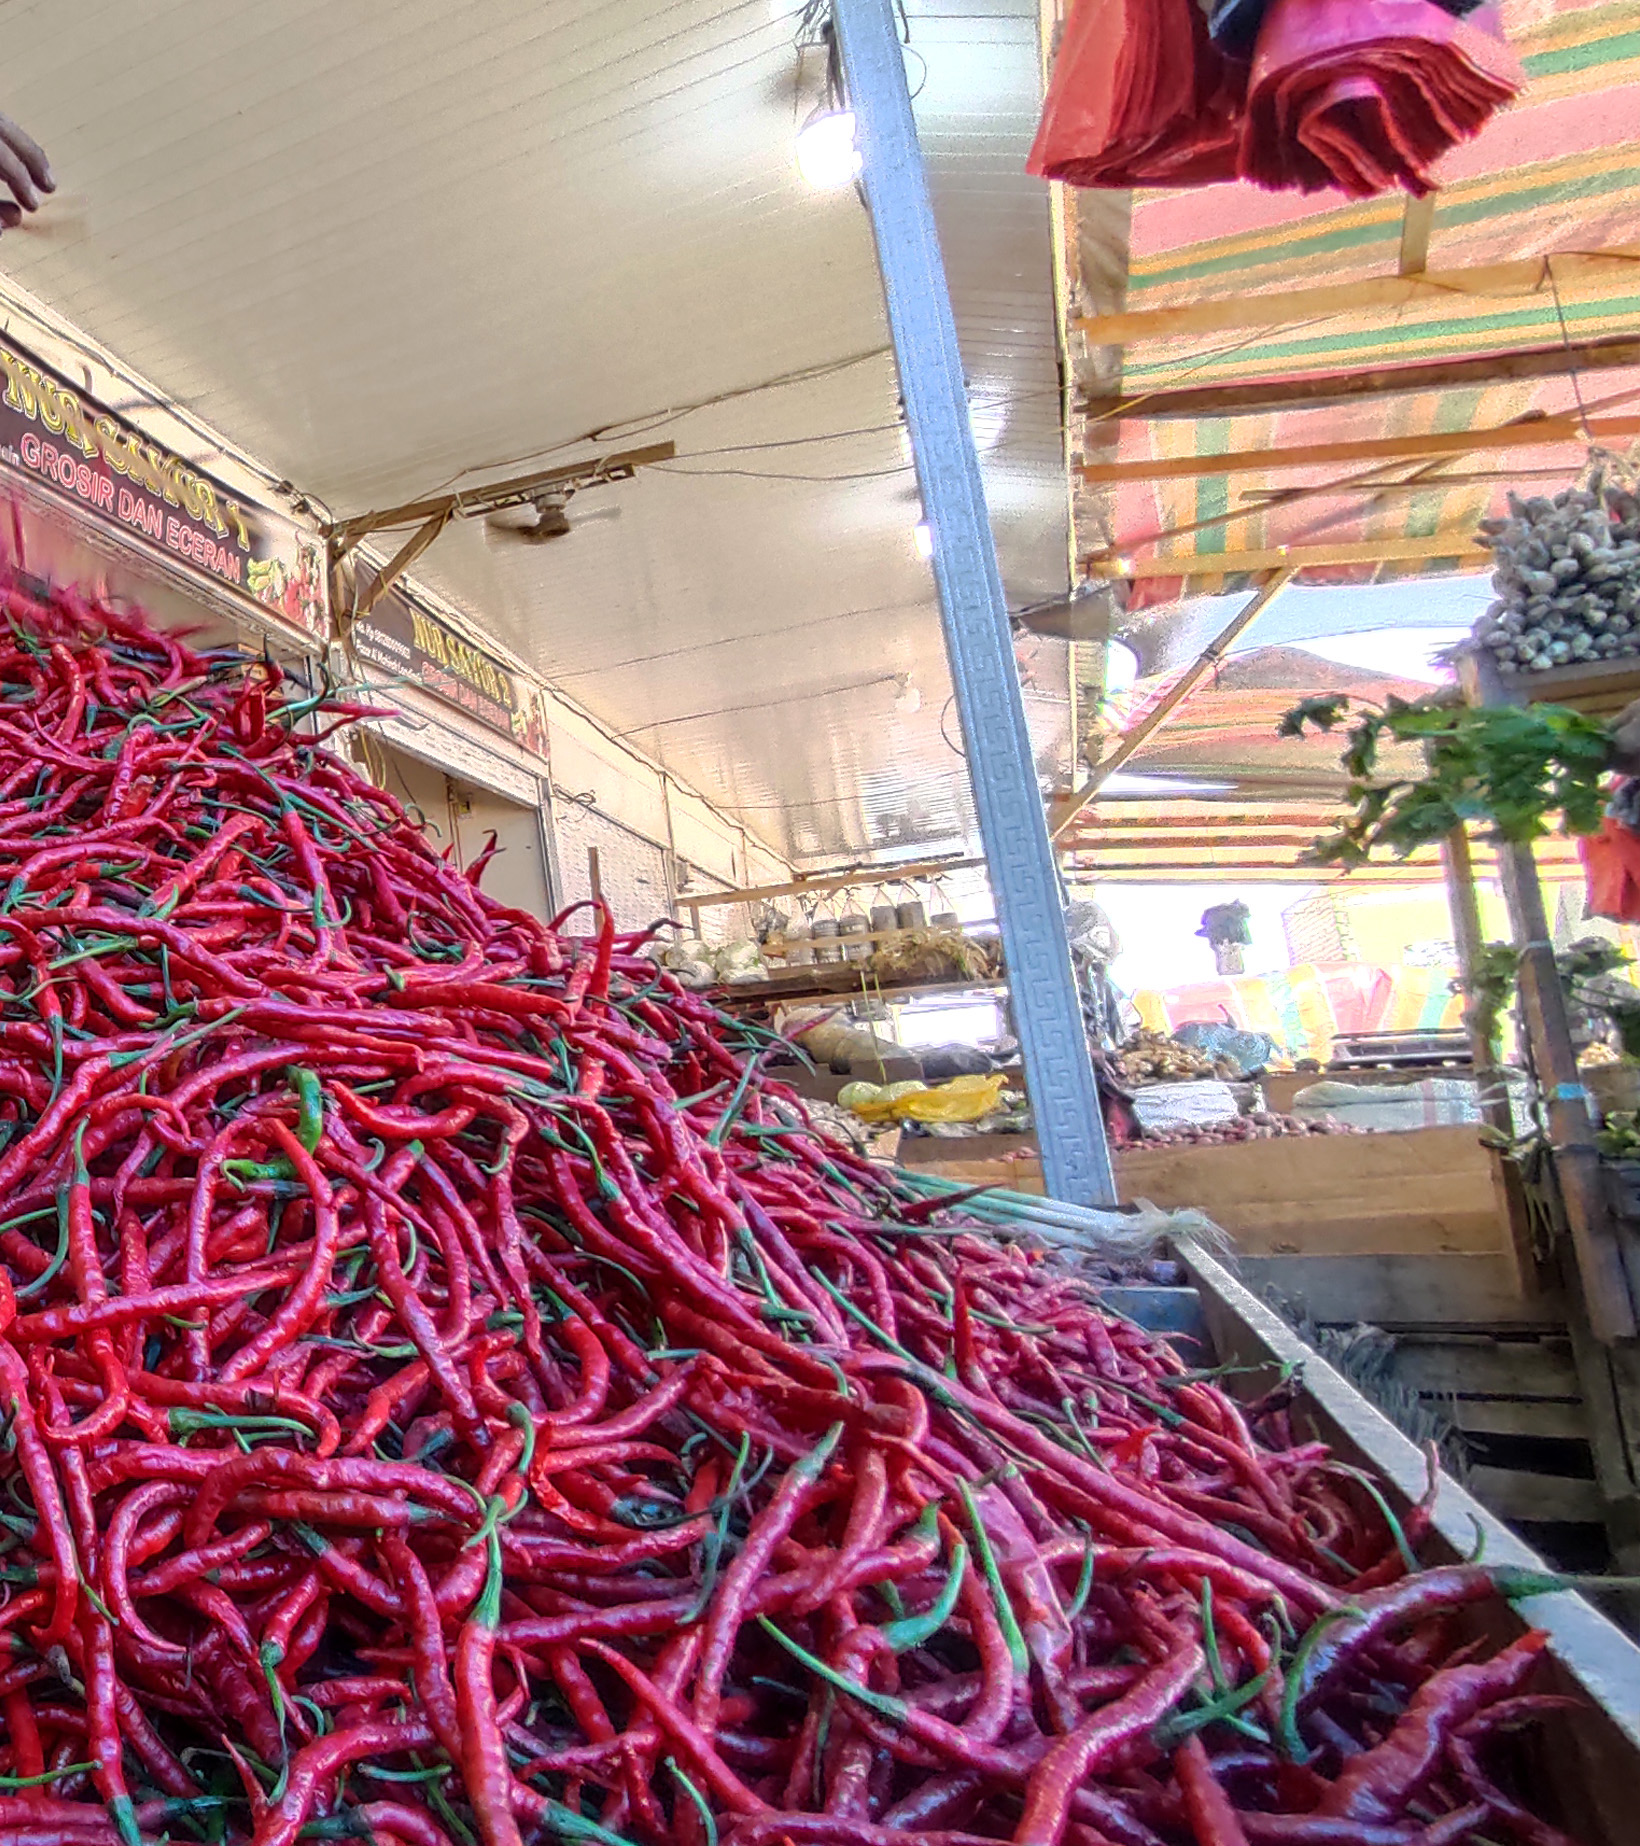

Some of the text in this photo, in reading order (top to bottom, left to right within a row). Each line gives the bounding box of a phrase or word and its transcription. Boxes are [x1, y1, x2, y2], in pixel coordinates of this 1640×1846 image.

[20, 432, 241, 584] GROSIR DAN ECERAN
